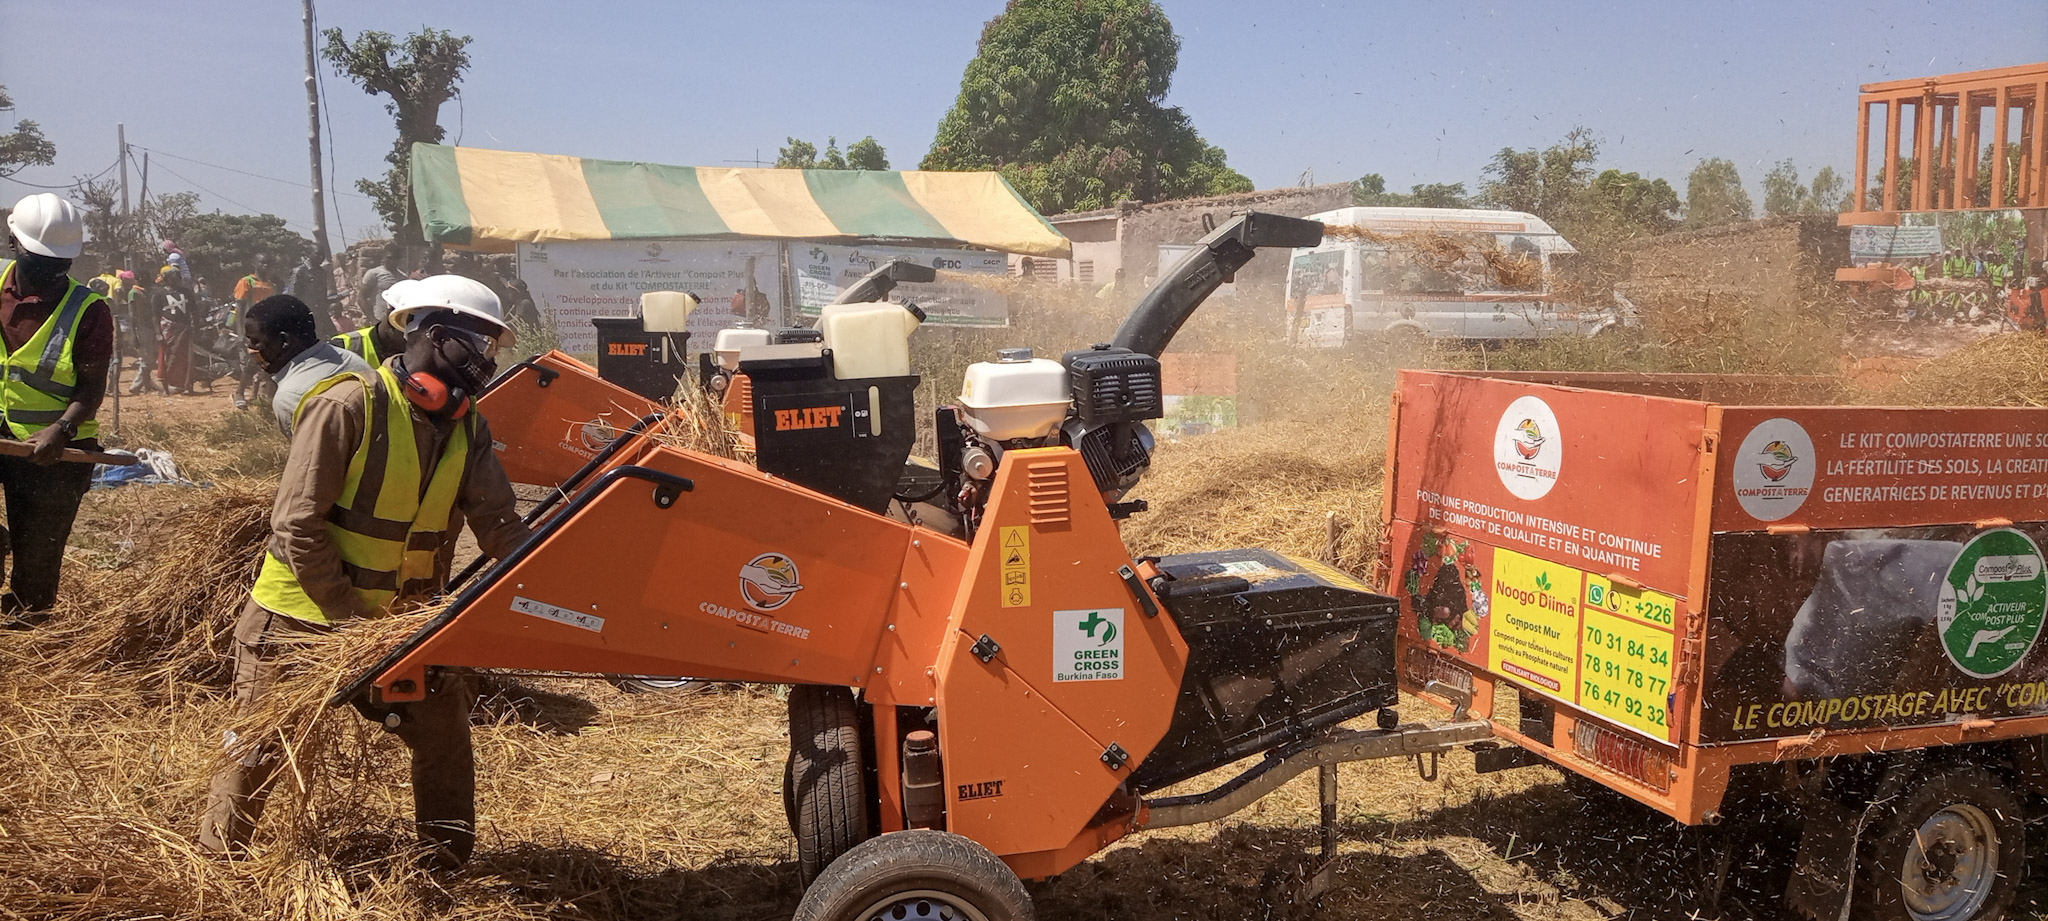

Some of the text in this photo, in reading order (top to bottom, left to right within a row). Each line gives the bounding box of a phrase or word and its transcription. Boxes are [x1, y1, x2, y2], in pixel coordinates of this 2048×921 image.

[553, 269, 569, 279] Par
[571, 268, 626, 279] l'association
[627, 269, 639, 279] de
[590, 282, 601, 290] et
[602, 281, 614, 290] du
[615, 281, 628, 290] Kit
[620, 295, 634, 304] des
[559, 307, 594, 316] continue
[598, 306, 609, 316] de
[703, 306, 714, 315] de
[715, 306, 732, 315] béta
[697, 318, 733, 329] l'élevage
[607, 342, 646, 356] ELIET
[774, 405, 842, 431] ELIET
[1840, 432, 1856, 448] LE
[1859, 432, 1883, 448] KIT
[1885, 432, 2003, 448] COMPOSTATERRE
[2005, 433, 2033, 448] UNE
[1497, 461, 1557, 480] COMPOSTATERRE
[1826, 460, 1844, 475] LA
[1848, 459, 1915, 475] FERTILITE
[1917, 459, 1943, 475] DES
[1944, 459, 1983, 477] SOLS,
[1986, 459, 2003, 474] LA
[1737, 487, 1809, 497] COMPOSTATERRE
[1823, 485, 1927, 502] GENERATRICES
[1929, 485, 1948, 501] DE
[1951, 484, 2012, 500] REVENUS
[2015, 484, 2031, 499] ET
[1416, 489, 1662, 558] POUR UNE PRODUCTION INTENSIVE ET CONTINUE
[1429, 507, 1441, 520] DE
[1443, 510, 1487, 530] COMPOST
[1488, 521, 1501, 536] DE
[1503, 526, 1547, 548] QUALITE
[1548, 536, 1563, 551] ET
[1564, 541, 1580, 556] EN
[1496, 579, 1575, 618] Noogo Diima
[1987, 601, 2027, 614] ACTIVEUR
[698, 601, 811, 640] COMPOSTATERRE
[1635, 601, 1671, 625] +226
[2006, 613, 2026, 624] PLUS
[1505, 613, 1561, 640] Compost Mur
[1074, 649, 1119, 660] GREEN
[1493, 628, 1574, 664] Compost pour toutes les cultures
[1586, 625, 1668, 667] 70 31 84 34
[1074, 660, 1119, 671] CROSS
[1498, 643, 1569, 674] enrichi au Phosphate naturel
[1057, 671, 1118, 681] Burkina Faso
[1585, 653, 1666, 696] 78 81 78 77
[1584, 680, 1665, 726] 76 47 92 32
[1732, 704, 1762, 731] LE
[1767, 690, 1929, 730] COMPOSTAGE
[1932, 687, 1992, 714] AVEC
[958, 780, 1004, 799] ELIET
